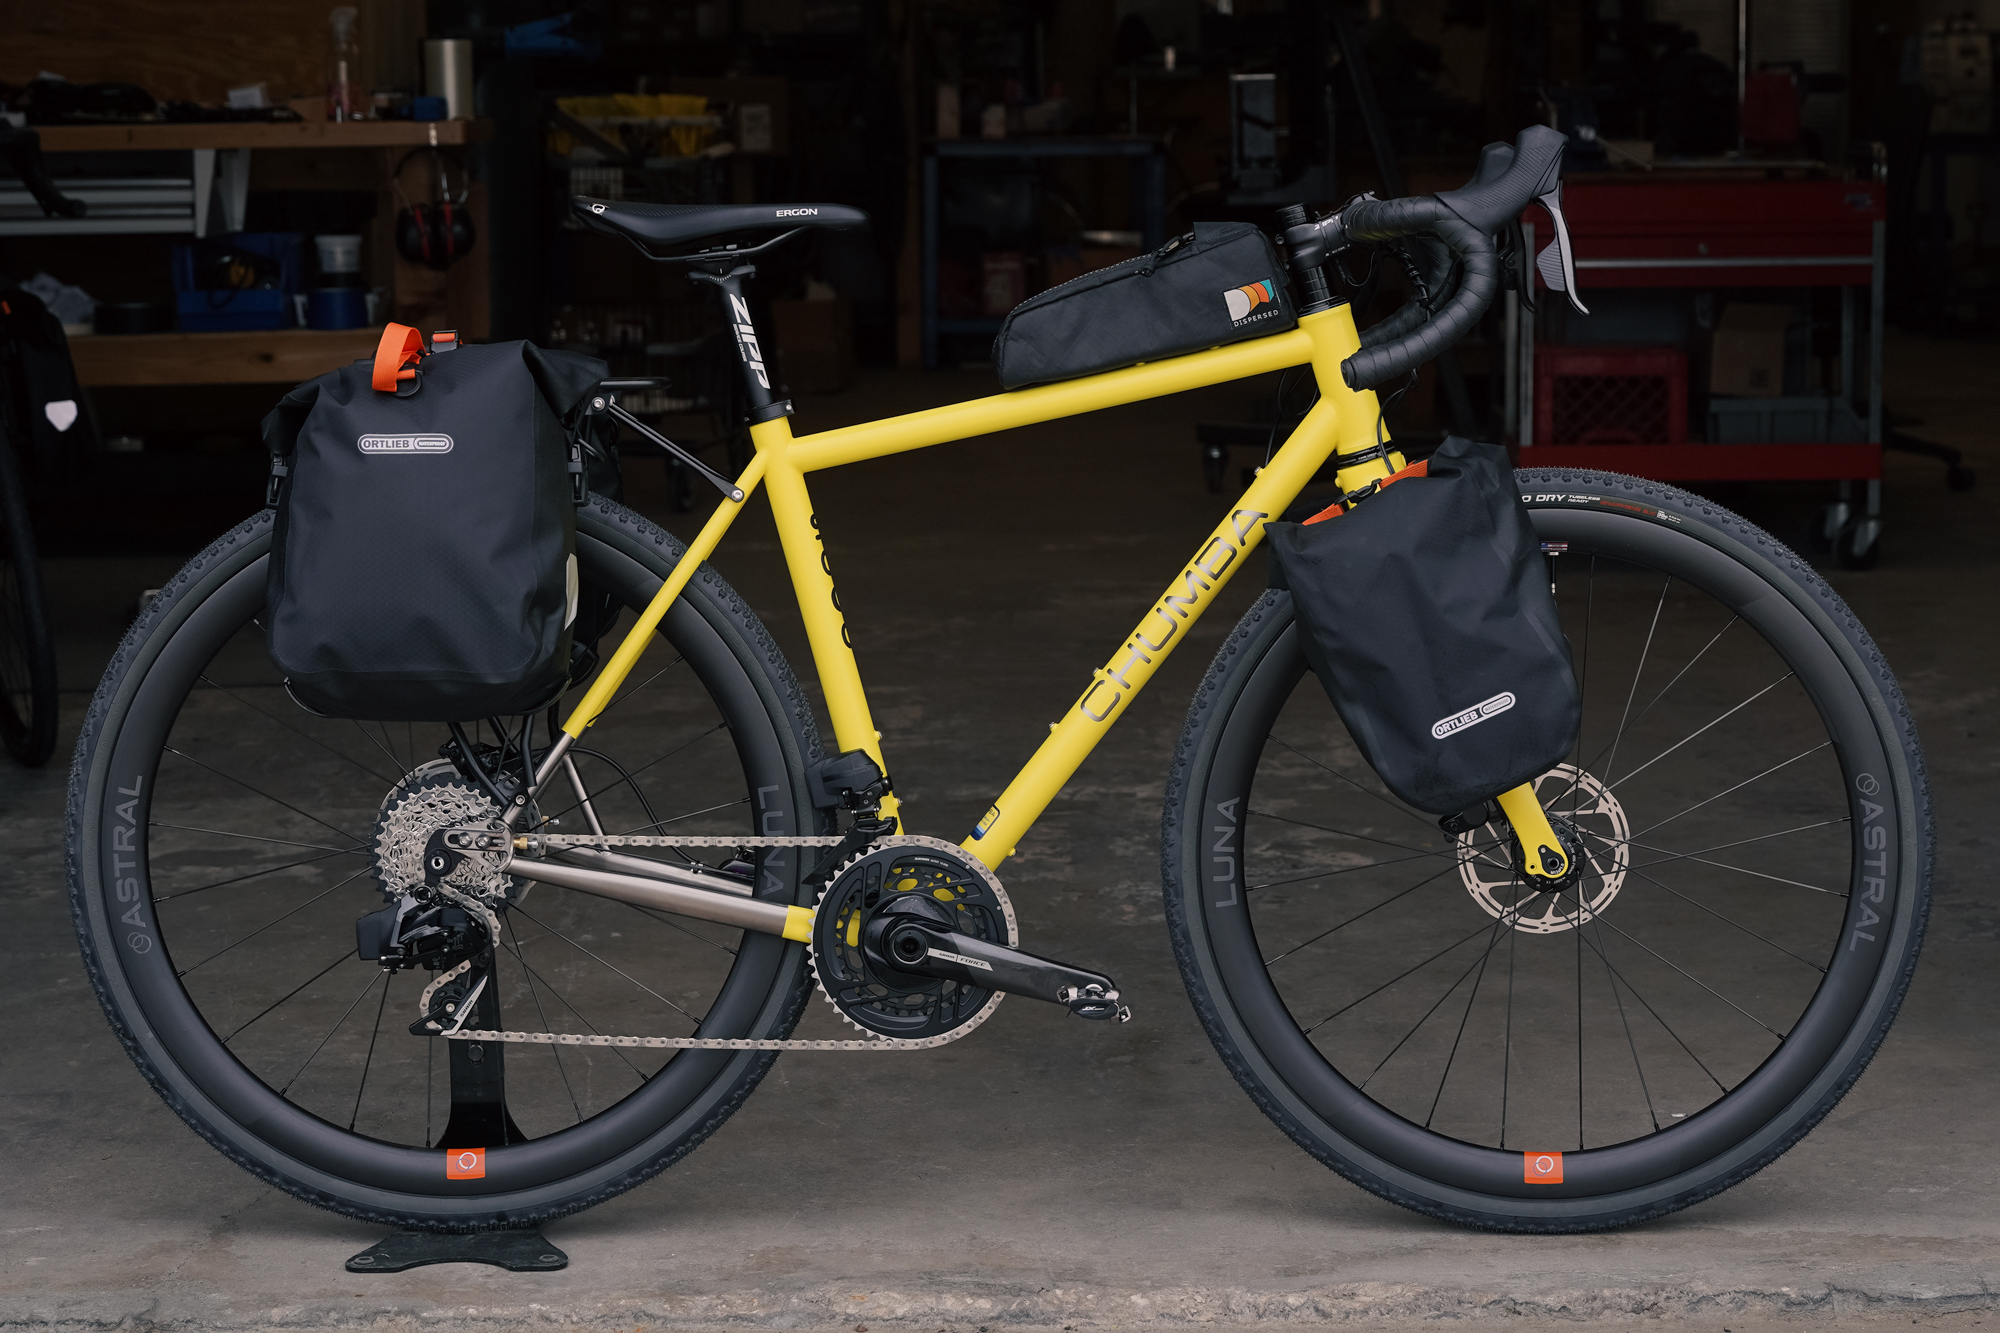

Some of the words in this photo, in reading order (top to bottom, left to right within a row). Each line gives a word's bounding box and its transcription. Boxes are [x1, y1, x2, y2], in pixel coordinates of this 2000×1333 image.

[776, 208, 818, 217] ERGON
[729, 293, 771, 390] ZIPP
[1233, 309, 1279, 328] DISPERSED
[363, 439, 410, 449] ORTLIEB
[1535, 494, 1566, 502] DRY
[1568, 494, 1601, 502] TUBELESS
[1080, 509, 1269, 723] CHUMBA
[1435, 710, 1479, 735] ORTLIEB
[112, 774, 147, 928] ASTRAL
[757, 784, 786, 897] LUNA
[1212, 796, 1241, 908] LUNA
[1849, 798, 1887, 952] ASTRAL
